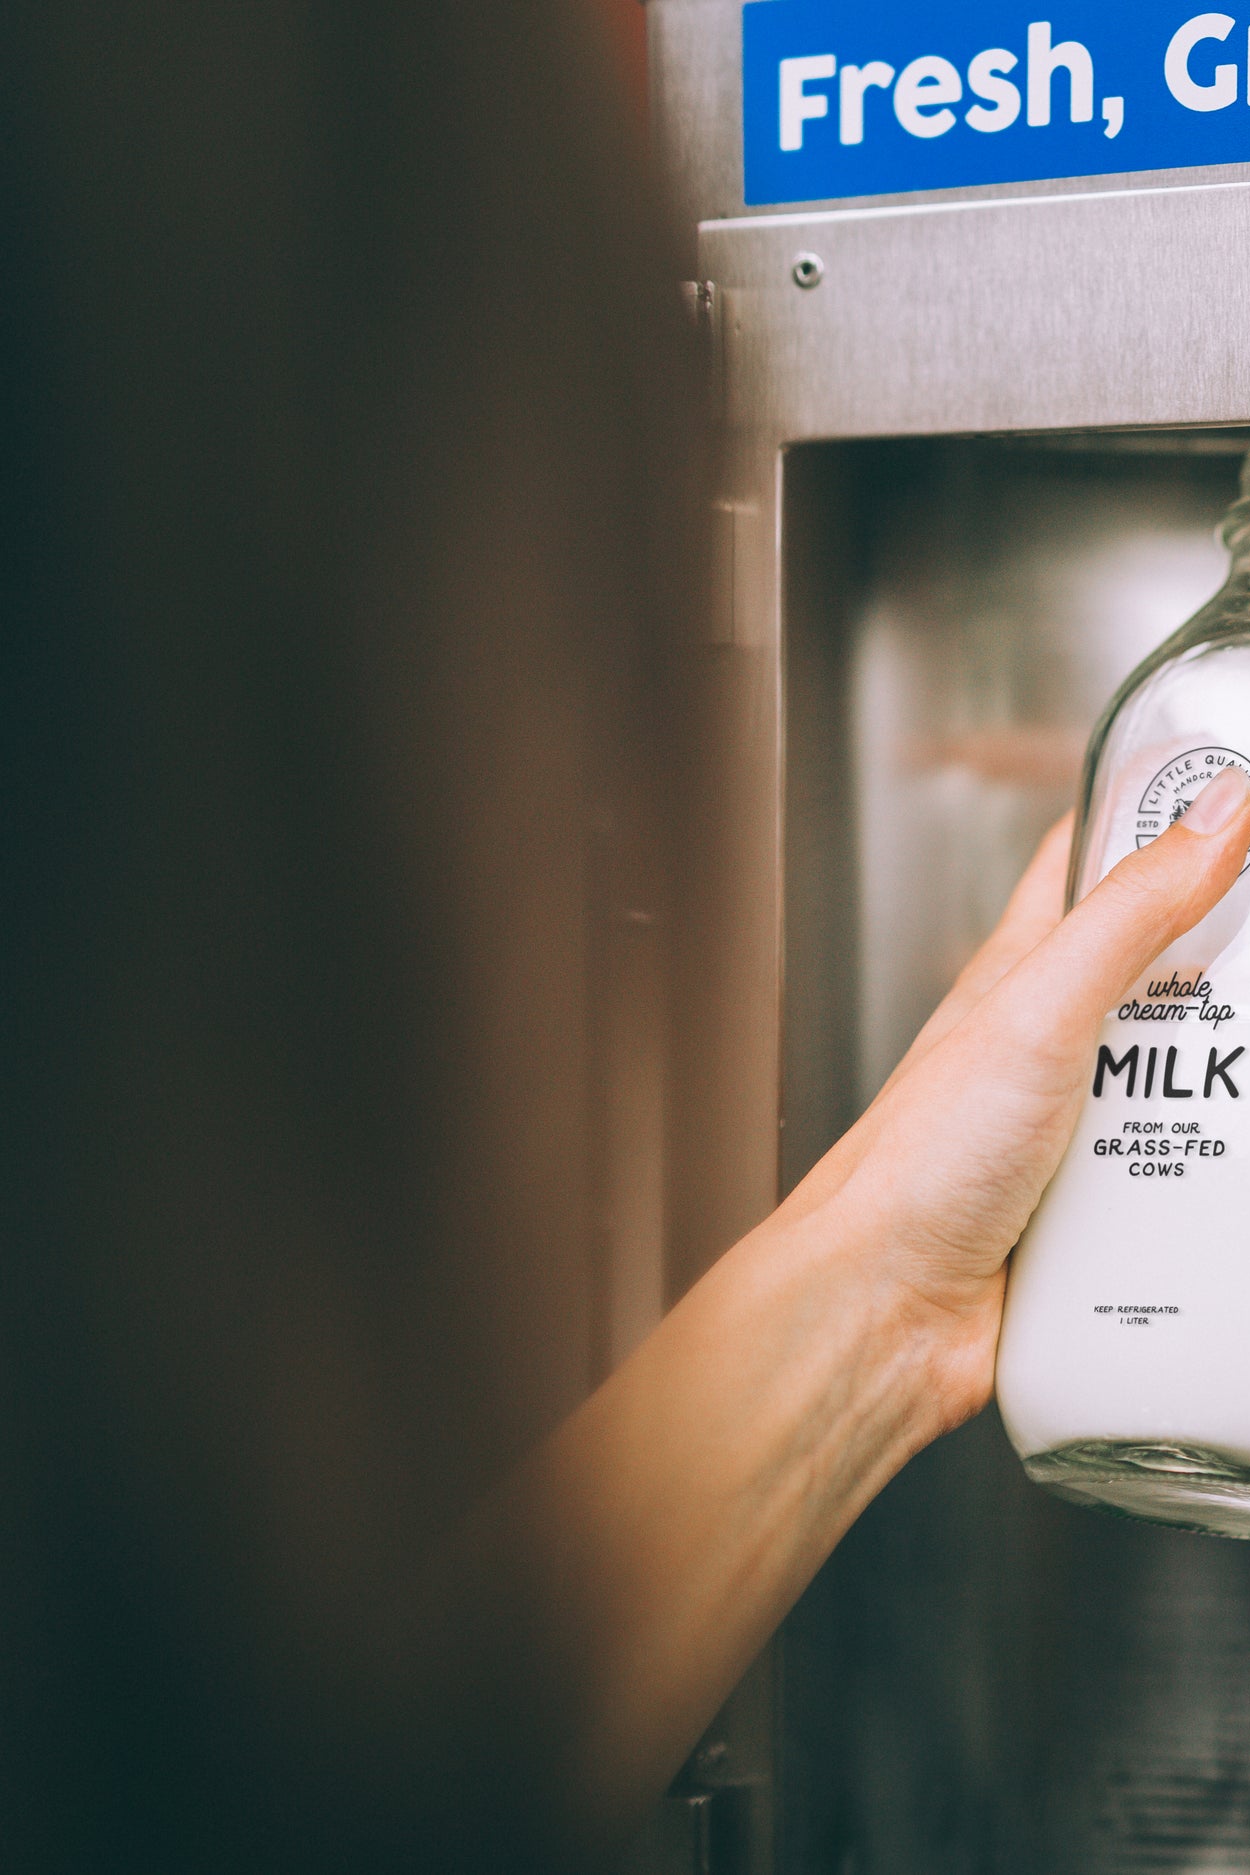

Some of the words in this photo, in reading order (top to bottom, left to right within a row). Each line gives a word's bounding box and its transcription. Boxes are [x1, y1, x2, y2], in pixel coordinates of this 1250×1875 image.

[779, 21, 1125, 151] Fresh,
[1148, 759, 1193, 805] LITTLE
[1136, 820, 1160, 829] ESTD
[1147, 971, 1213, 998] whole
[1117, 995, 1235, 1031] cream-top
[1092, 1044, 1246, 1099] MILK
[1122, 1121, 1164, 1134] FROM
[1171, 1122, 1201, 1134] OUR
[1093, 1138, 1226, 1157] GRASS-FED
[1128, 1162, 1185, 1177] COWS
[1093, 1305, 1114, 1314] KEEP
[1117, 1305, 1179, 1314] REFRIGERATED
[1126, 1316, 1150, 1325] LITER
